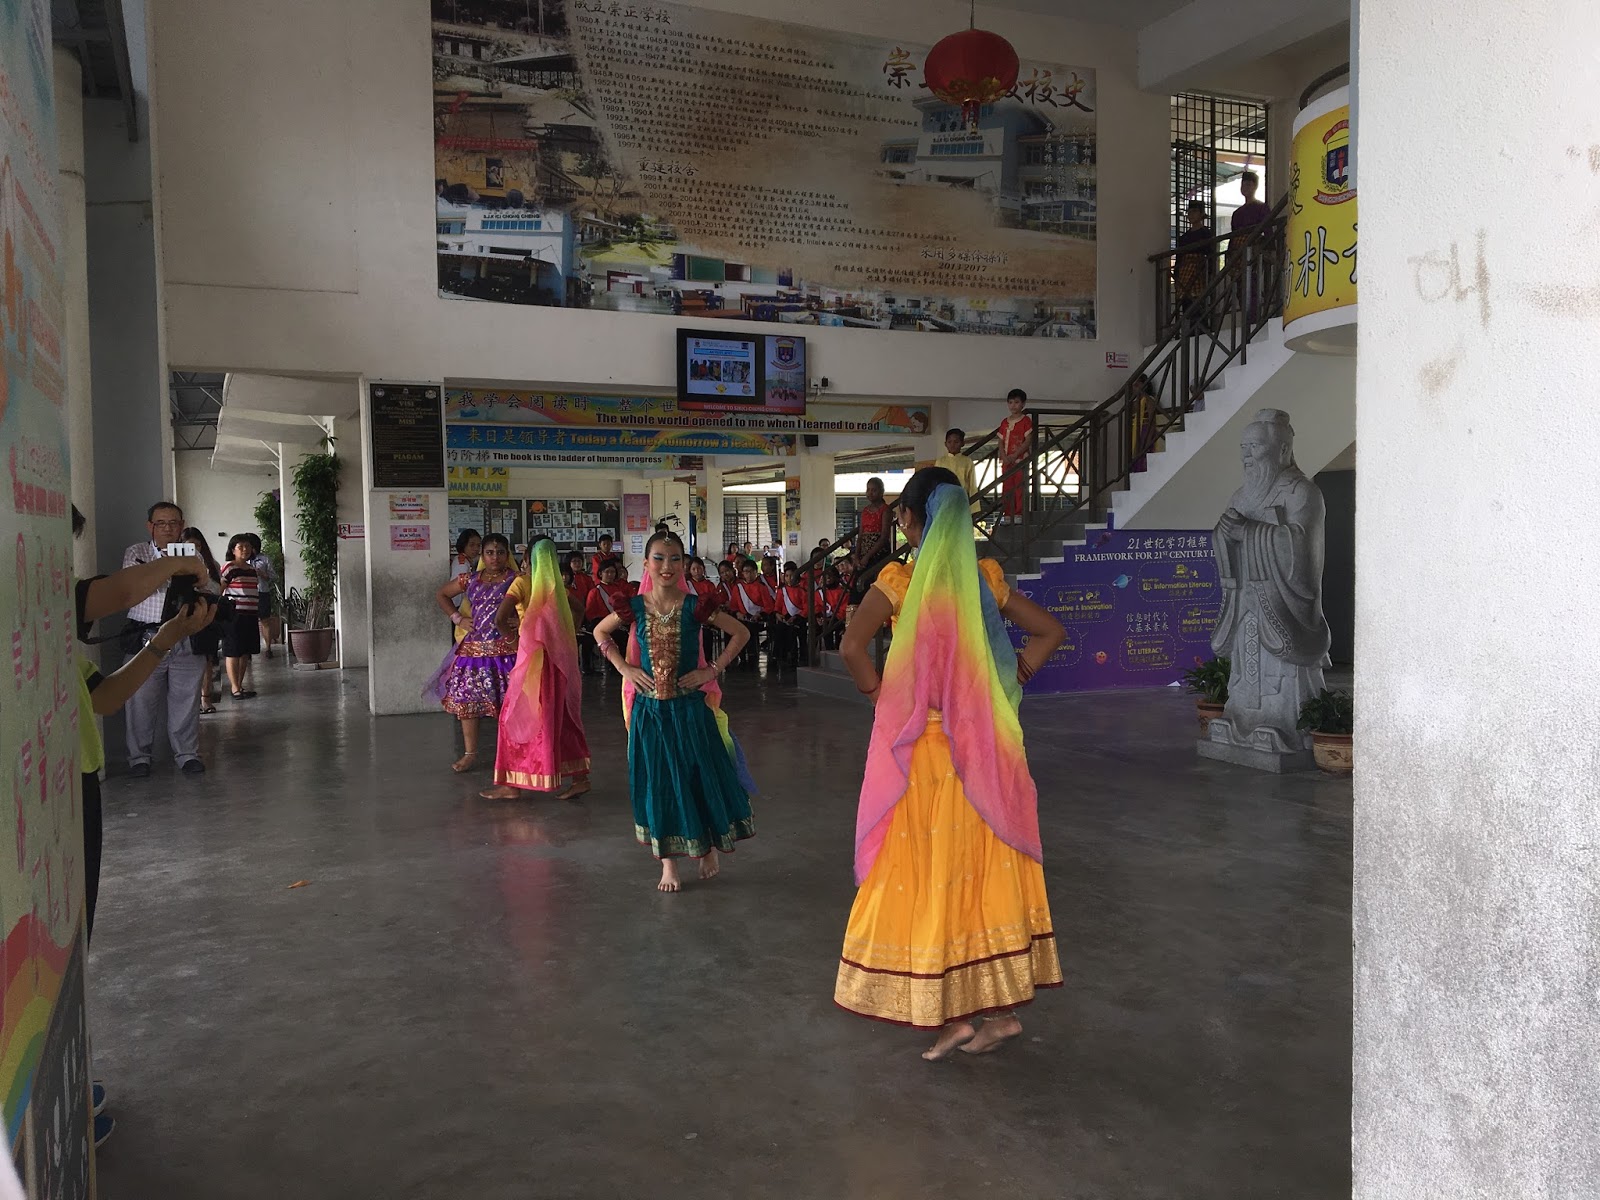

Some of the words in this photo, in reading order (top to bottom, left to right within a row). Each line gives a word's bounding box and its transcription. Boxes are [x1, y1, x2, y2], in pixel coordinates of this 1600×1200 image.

[596, 413, 617, 425] The
[619, 413, 655, 425] whole
[657, 415, 689, 427] world
[691, 416, 733, 430] opened
[736, 417, 746, 428] to
[748, 420, 765, 429] me
[766, 418, 796, 429] when
[803, 419, 842, 431] learned
[844, 421, 855, 430] to
[857, 421, 880, 431] read
[570, 433, 606, 446] Today
[609, 435, 617, 445] a
[619, 434, 659, 447] reader
[722, 439, 728, 448] a
[493, 452, 509, 461] The
[510, 452, 531, 462] book
[533, 453, 541, 461] is
[542, 453, 556, 462] the
[558, 454, 585, 463] ladder
[587, 454, 596, 463] of
[597, 454, 625, 463] human
[626, 455, 662, 466] progress
[470, 481, 503, 492] BACAAN
[1074, 551, 1133, 563] FRAMEWORK
[1135, 551, 1152, 561] FOR
[1169, 549, 1209, 560] CENTURY
[1153, 582, 1188, 591] Information
[1188, 581, 1213, 590] Literacy
[1047, 604, 1074, 613] Creative
[1081, 603, 1113, 611] Innovation
